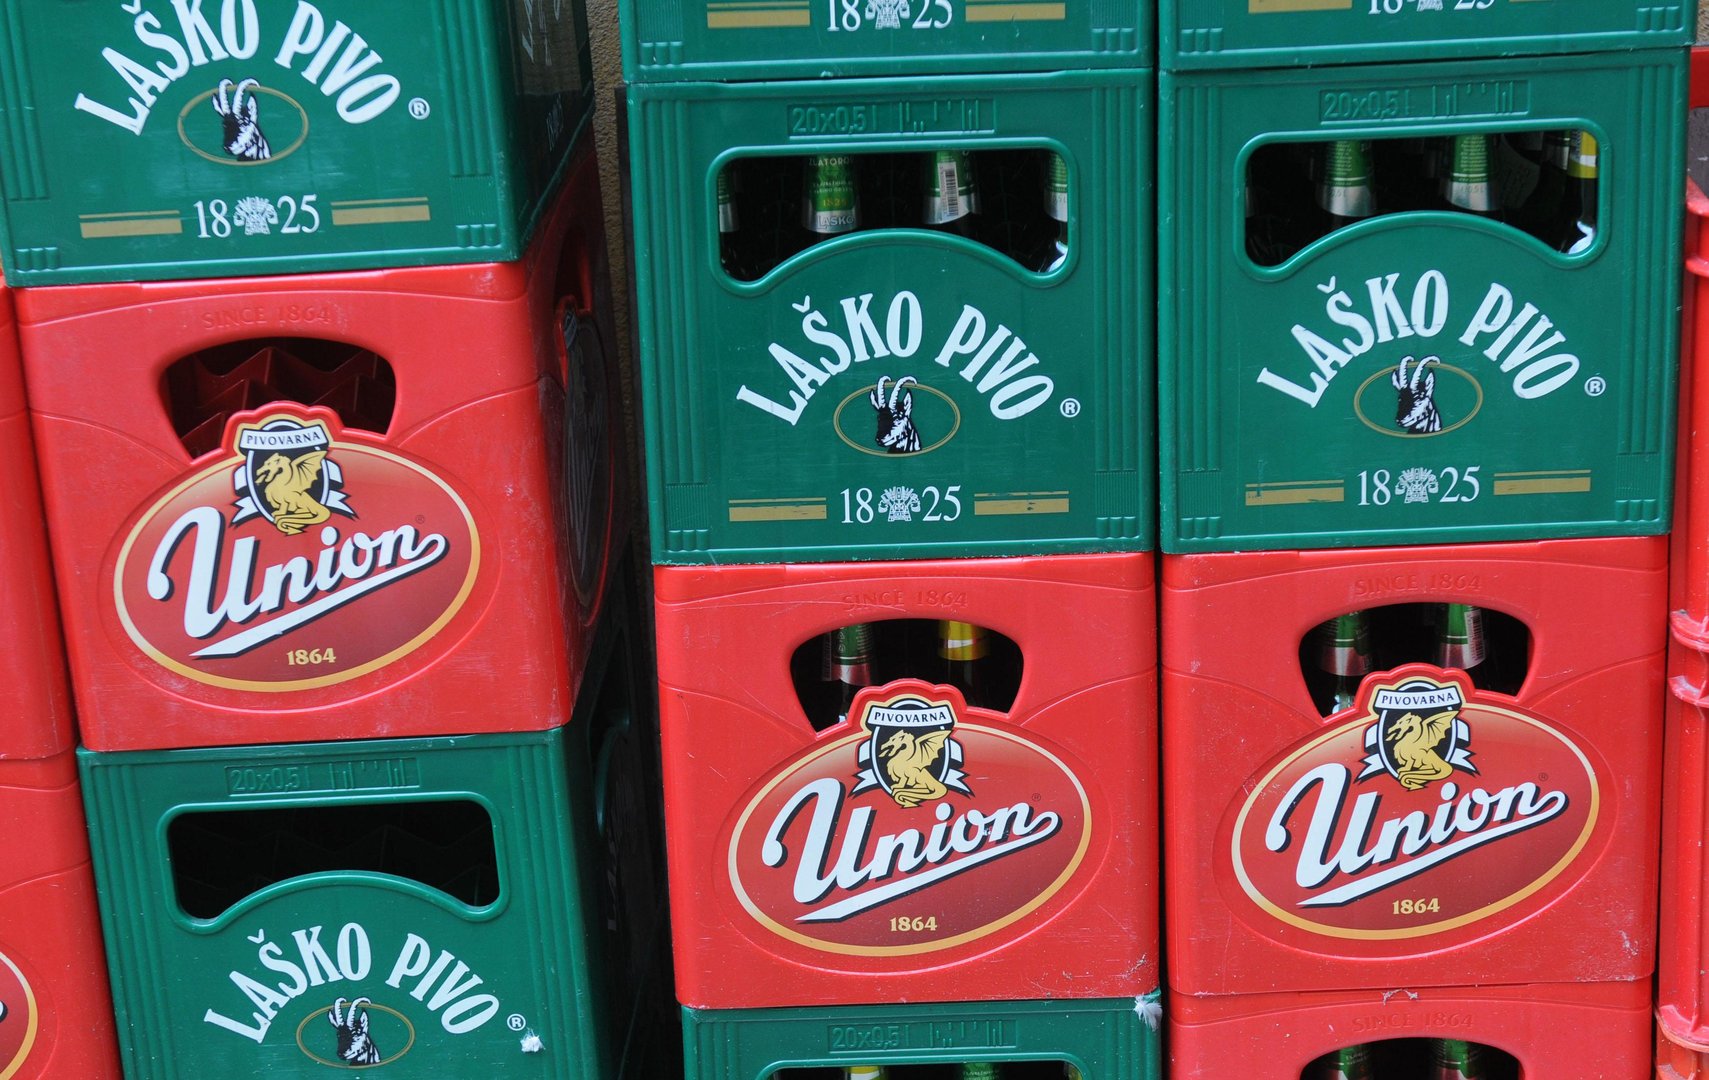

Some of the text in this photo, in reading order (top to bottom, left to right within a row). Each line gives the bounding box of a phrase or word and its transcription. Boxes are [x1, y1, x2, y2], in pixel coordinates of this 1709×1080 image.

[75, 0, 260, 136] LAŠKO
[273, 1, 401, 124] PIVO
[809, 156, 856, 168] ZLATORO
[195, 194, 320, 238] 18 25
[201, 307, 267, 330] SINCE
[1257, 269, 1449, 409] LAŠKO
[1458, 282, 1580, 400] PIVO
[736, 290, 923, 426] LAŠKO
[934, 304, 1054, 420] PIVO
[246, 431, 321, 446] PIVOVARNA
[1358, 466, 1480, 506] 18 25
[841, 485, 961, 524] 18 25
[147, 506, 448, 658] Union
[1355, 573, 1481, 596] SINCE 1864
[842, 590, 969, 612] SINCE 1864
[286, 647, 337, 666] 1864
[1382, 692, 1455, 706] PIVOVARNA
[874, 711, 947, 723] PIVOVARNA
[1266, 763, 1567, 906] Union
[761, 777, 1061, 922] Union
[1392, 898, 1441, 915] 1864
[889, 916, 938, 932] 1864
[204, 922, 372, 1044] LAŠKO
[385, 933, 500, 1034] PIVO
[1352, 1011, 1473, 1033] SINCE 1864
